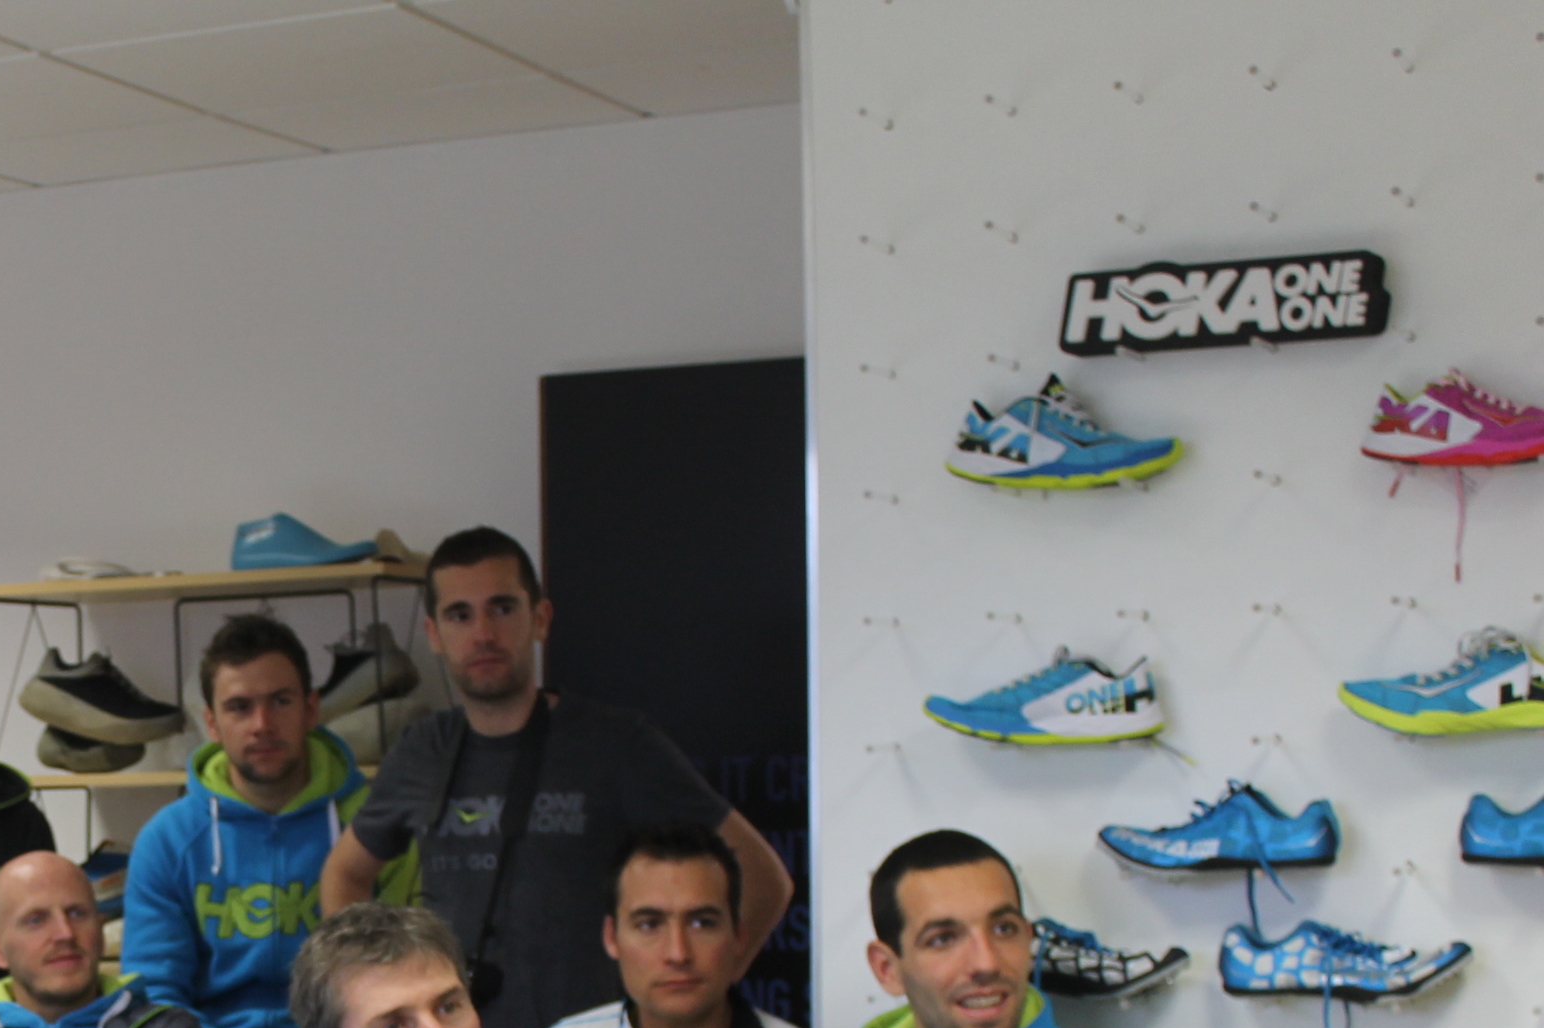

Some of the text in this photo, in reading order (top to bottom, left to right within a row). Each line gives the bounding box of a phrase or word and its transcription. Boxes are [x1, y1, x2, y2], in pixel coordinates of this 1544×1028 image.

[1274, 258, 1364, 298] ONE
[1063, 266, 1281, 345] HOKA
[1279, 292, 1369, 332] ONE
[194, 880, 322, 940] HOK
